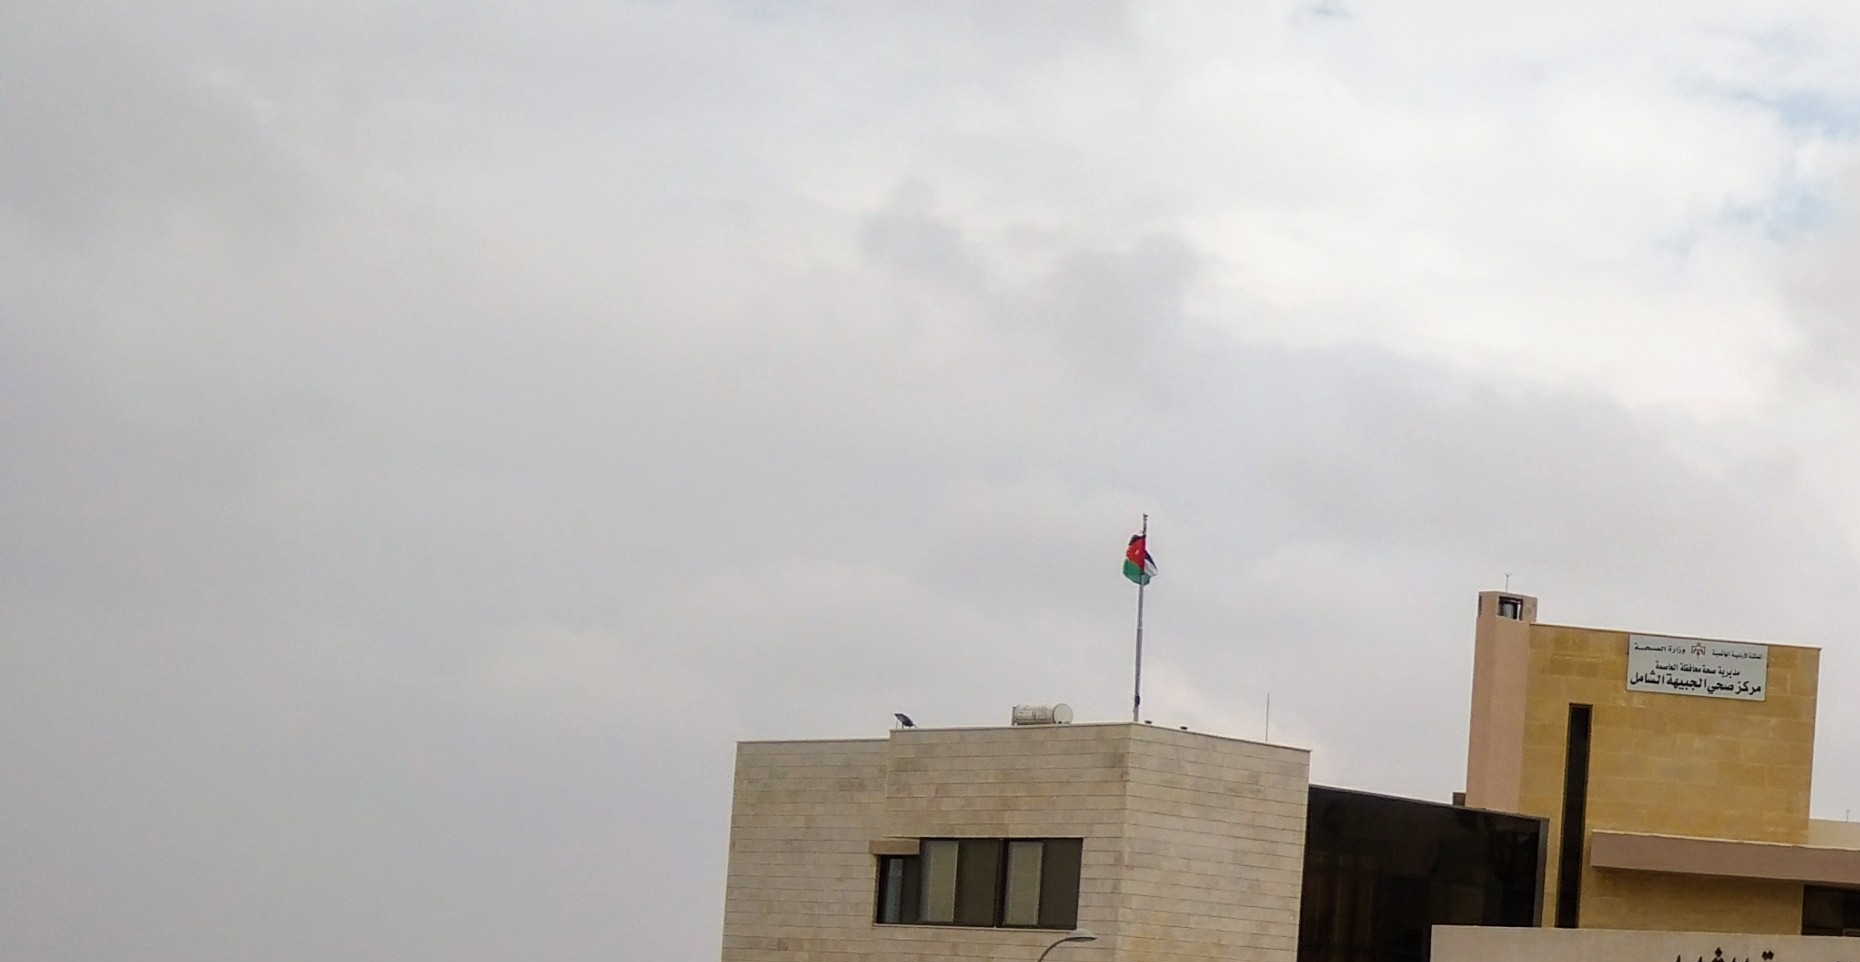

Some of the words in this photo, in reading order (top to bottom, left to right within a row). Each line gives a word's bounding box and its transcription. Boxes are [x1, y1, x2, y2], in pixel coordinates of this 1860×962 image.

[1668, 646, 1686, 655] وزارة
[1655, 660, 1679, 672] العاصمة
[1702, 664, 1716, 676] صحة
[1718, 665, 1740, 679] مديرية
[1630, 669, 1665, 686] الشامل
[1666, 672, 1707, 692] الجبيهة
[1706, 680, 1734, 695] صحي
[1736, 679, 1762, 697] مركز
